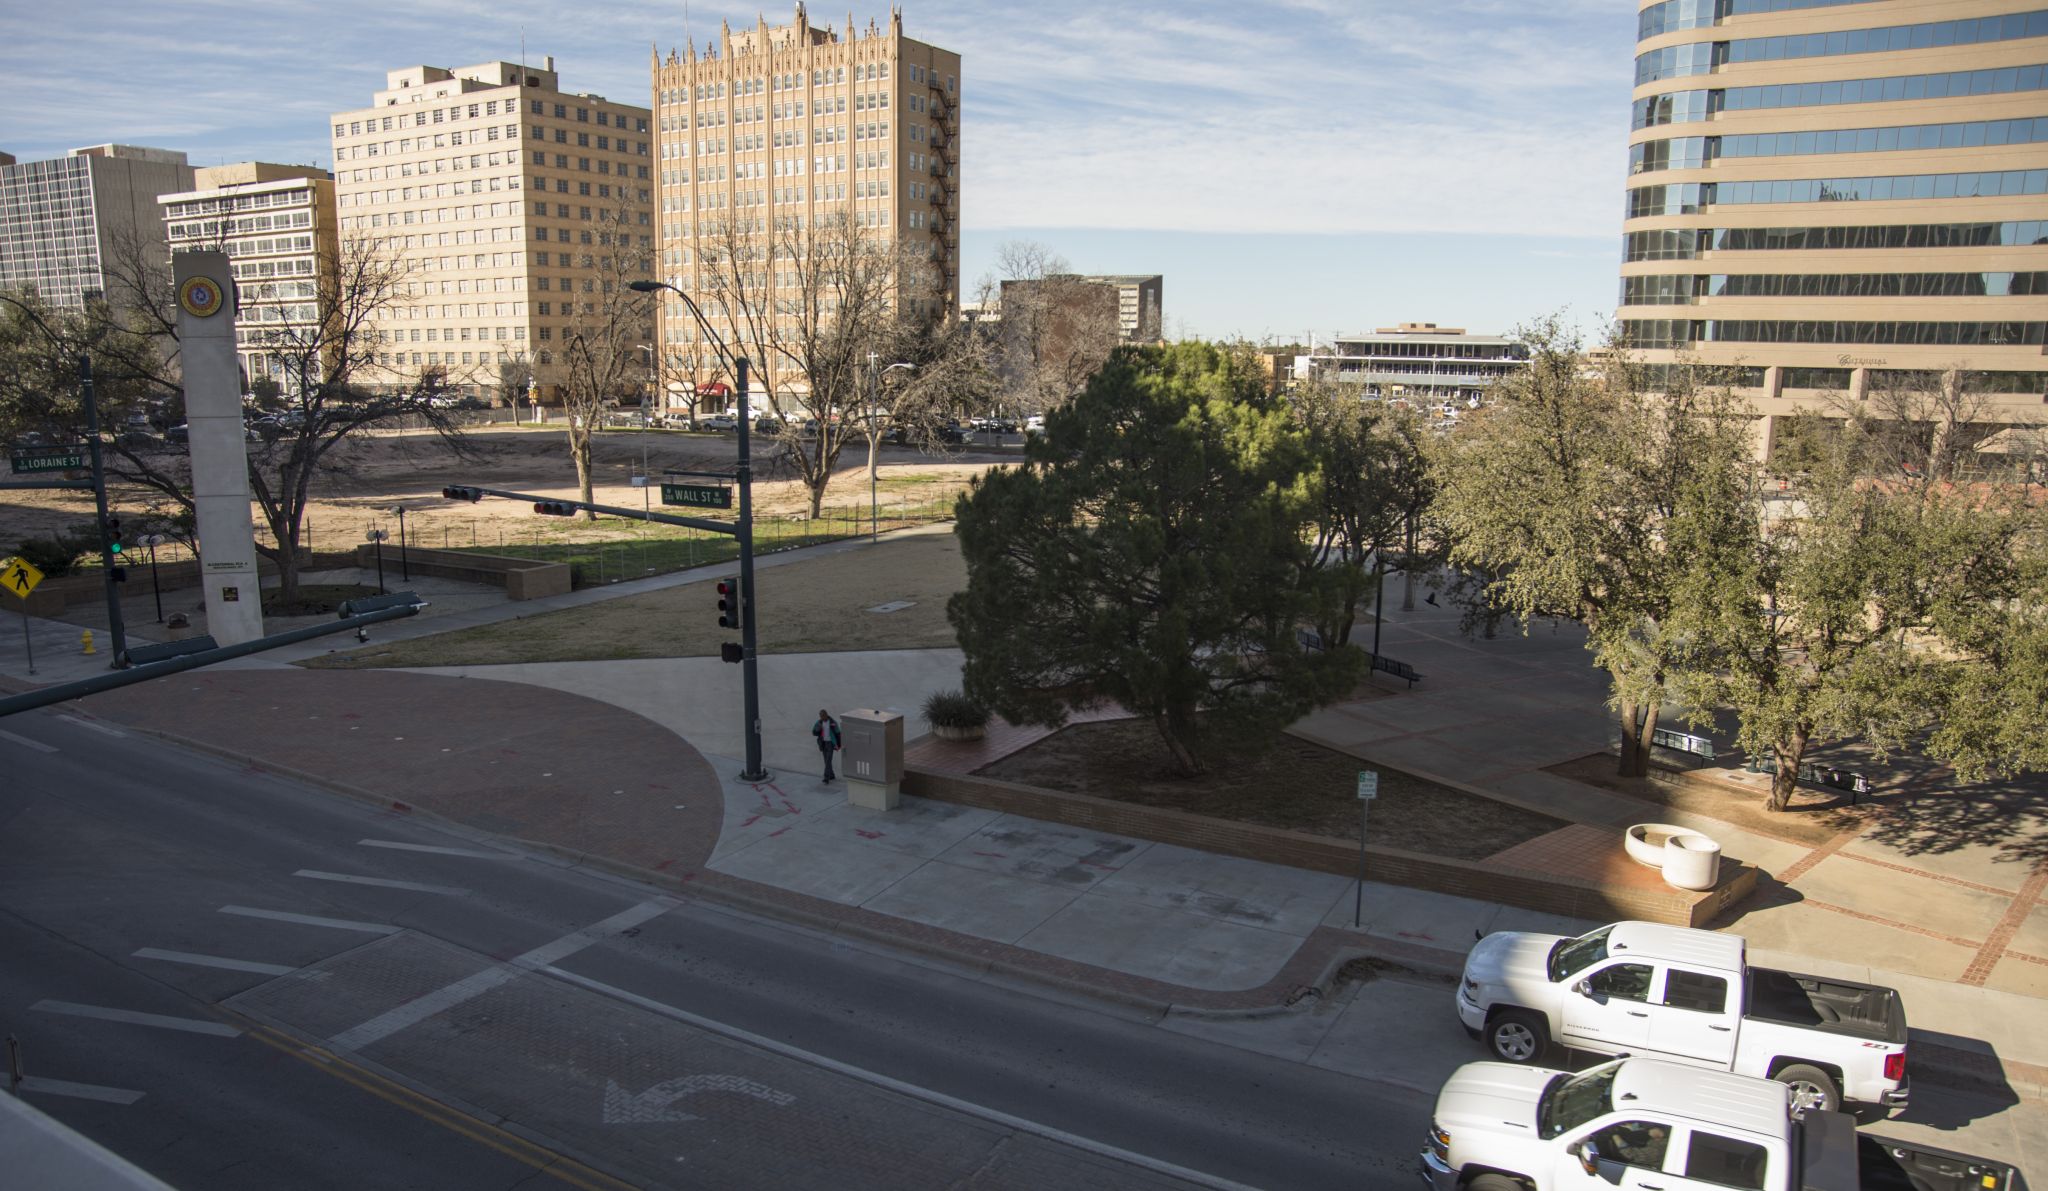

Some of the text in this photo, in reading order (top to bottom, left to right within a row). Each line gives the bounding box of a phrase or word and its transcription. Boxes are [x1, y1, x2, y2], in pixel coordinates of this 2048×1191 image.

[28, 456, 80, 469] LORAINE ST
[674, 489, 711, 503] WALL ST
